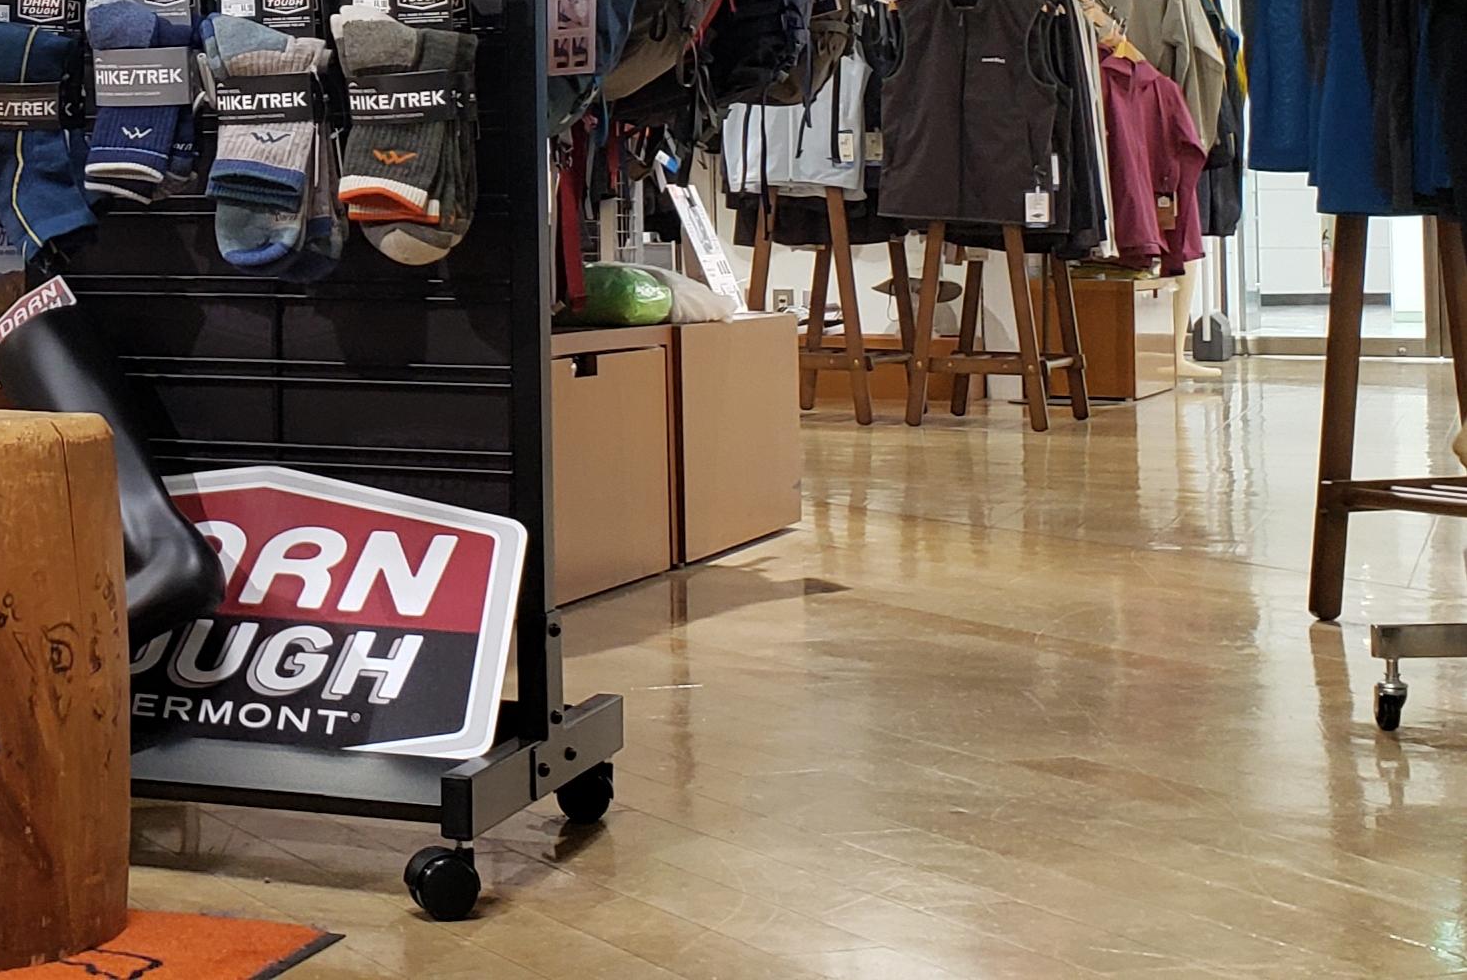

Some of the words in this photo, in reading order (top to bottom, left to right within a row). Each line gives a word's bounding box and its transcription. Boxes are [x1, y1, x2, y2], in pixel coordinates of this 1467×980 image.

[21, 5, 60, 16] TOUGH
[96, 68, 184, 86] HIKE/TREK
[216, 91, 308, 111] HIKE/TREK
[349, 89, 447, 111] HIKE/TREK
[0, 282, 59, 339] DARN
[193, 518, 460, 618] ARN
[131, 693, 348, 735] ERMONT
